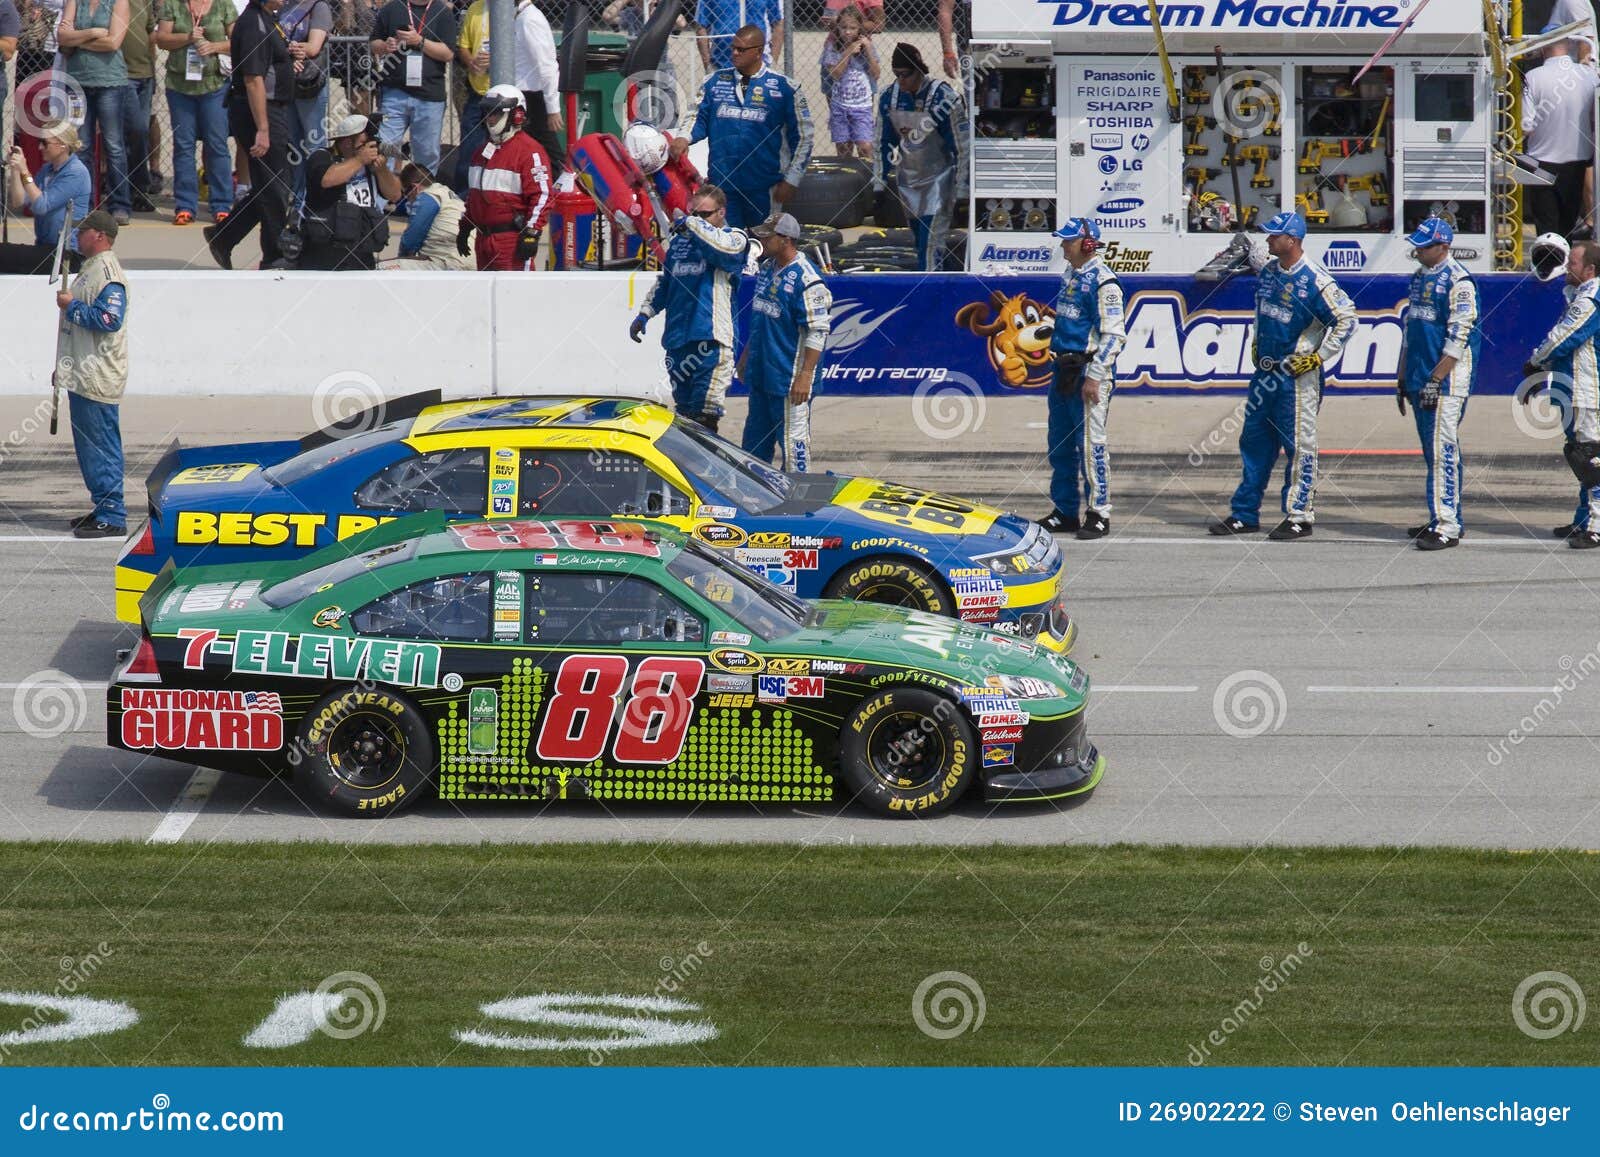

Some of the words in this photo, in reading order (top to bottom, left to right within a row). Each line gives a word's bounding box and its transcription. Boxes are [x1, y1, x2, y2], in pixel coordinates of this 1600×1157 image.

[1052, 0, 1206, 26] Dream
[1211, 0, 1412, 27] Machine
[1084, 70, 1156, 81] Panasonic
[1077, 86, 1161, 97] FRIGIDAIRE
[1087, 101, 1154, 112] SHARP
[1086, 117, 1154, 128] TOSHIBA
[1122, 159, 1143, 171] LG
[1102, 201, 1140, 209] SAMSUNG
[1094, 218, 1147, 228] PHILIPS
[979, 243, 1052, 262] Aaron's
[1104, 241, 1153, 261] 5-hour
[1329, 250, 1361, 268] NAPA
[1103, 262, 1151, 272] NERGY
[877, 365, 947, 382] racing
[176, 511, 327, 547] BEST
[791, 535, 823, 549] Holley
[851, 537, 929, 555] GOODYEAR
[746, 554, 782, 563] freescale
[783, 550, 818, 569] 3M
[1012, 555, 1030, 573] 17
[949, 568, 991, 578] MOOG
[496, 583, 520, 595] MAC
[849, 564, 943, 613] GOODYEAR
[956, 580, 1003, 594] MAHLE
[962, 596, 998, 607] COMP
[960, 609, 998, 620] Edelbrock
[812, 659, 847, 675] Holley
[759, 676, 785, 697] USG
[870, 668, 949, 689] GOODYEAR
[787, 677, 823, 697] 3M
[961, 687, 1004, 696] MOOG
[1020, 678, 1047, 697] 88
[121, 688, 246, 711] NATIONAL
[708, 694, 755, 708] JEGS
[972, 700, 1020, 712] MAHLE
[536, 654, 706, 764] 88
[851, 693, 893, 733] EAGLE
[308, 692, 405, 745] GOODYEAR
[981, 714, 1018, 725] COMP
[121, 708, 283, 751] GUARD
[982, 730, 1022, 741] Edelbrock
[888, 740, 966, 811] GOODYEAR
[357, 783, 406, 810] EAGLE
